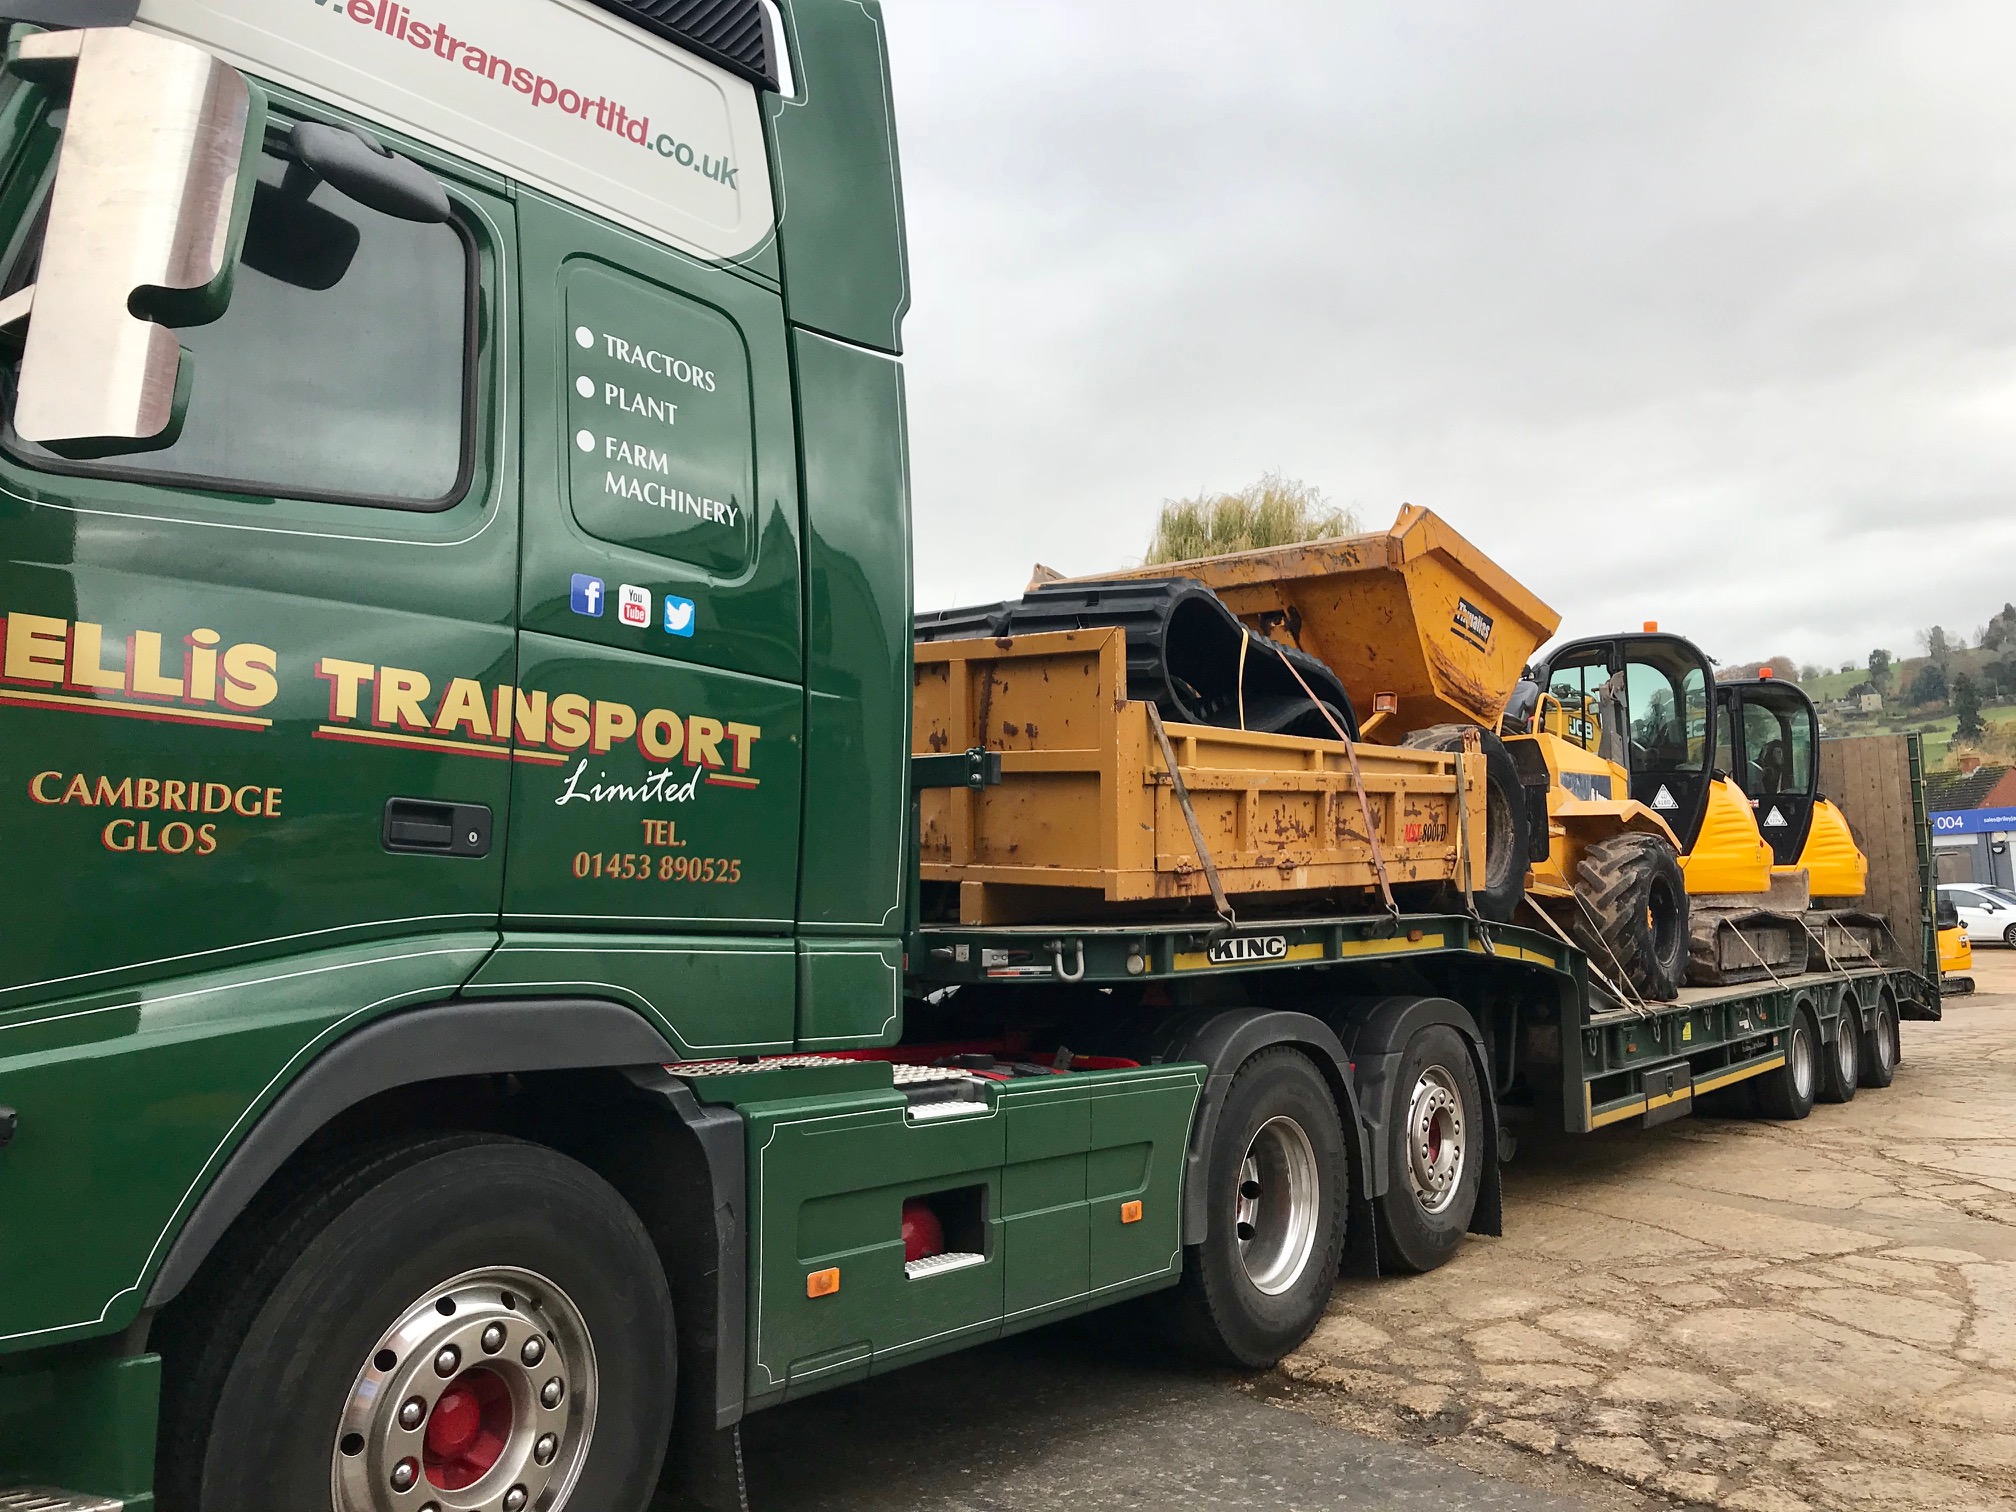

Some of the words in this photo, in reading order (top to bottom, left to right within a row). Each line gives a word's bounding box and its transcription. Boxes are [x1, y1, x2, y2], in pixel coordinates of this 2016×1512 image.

[315, 0, 739, 191] .ellistransportltd.co.uk
[603, 333, 716, 393] TRACTORS
[604, 382, 678, 425] PLANT
[604, 436, 669, 475] FARM
[604, 471, 739, 527] MACHINERY
[625, 604, 645, 622] Tube
[628, 589, 643, 603] You
[315, 657, 761, 772] TRANSPORT
[1569, 717, 1593, 740] JCB
[28, 771, 283, 818] CAMBRIDGE
[555, 758, 702, 806] Limited
[101, 819, 217, 856] GLOS
[641, 818, 687, 848] TEL.
[1937, 815, 1964, 829] 004
[572, 851, 651, 881] 01453
[658, 855, 742, 885] 890525
[1214, 938, 1283, 960] KING
